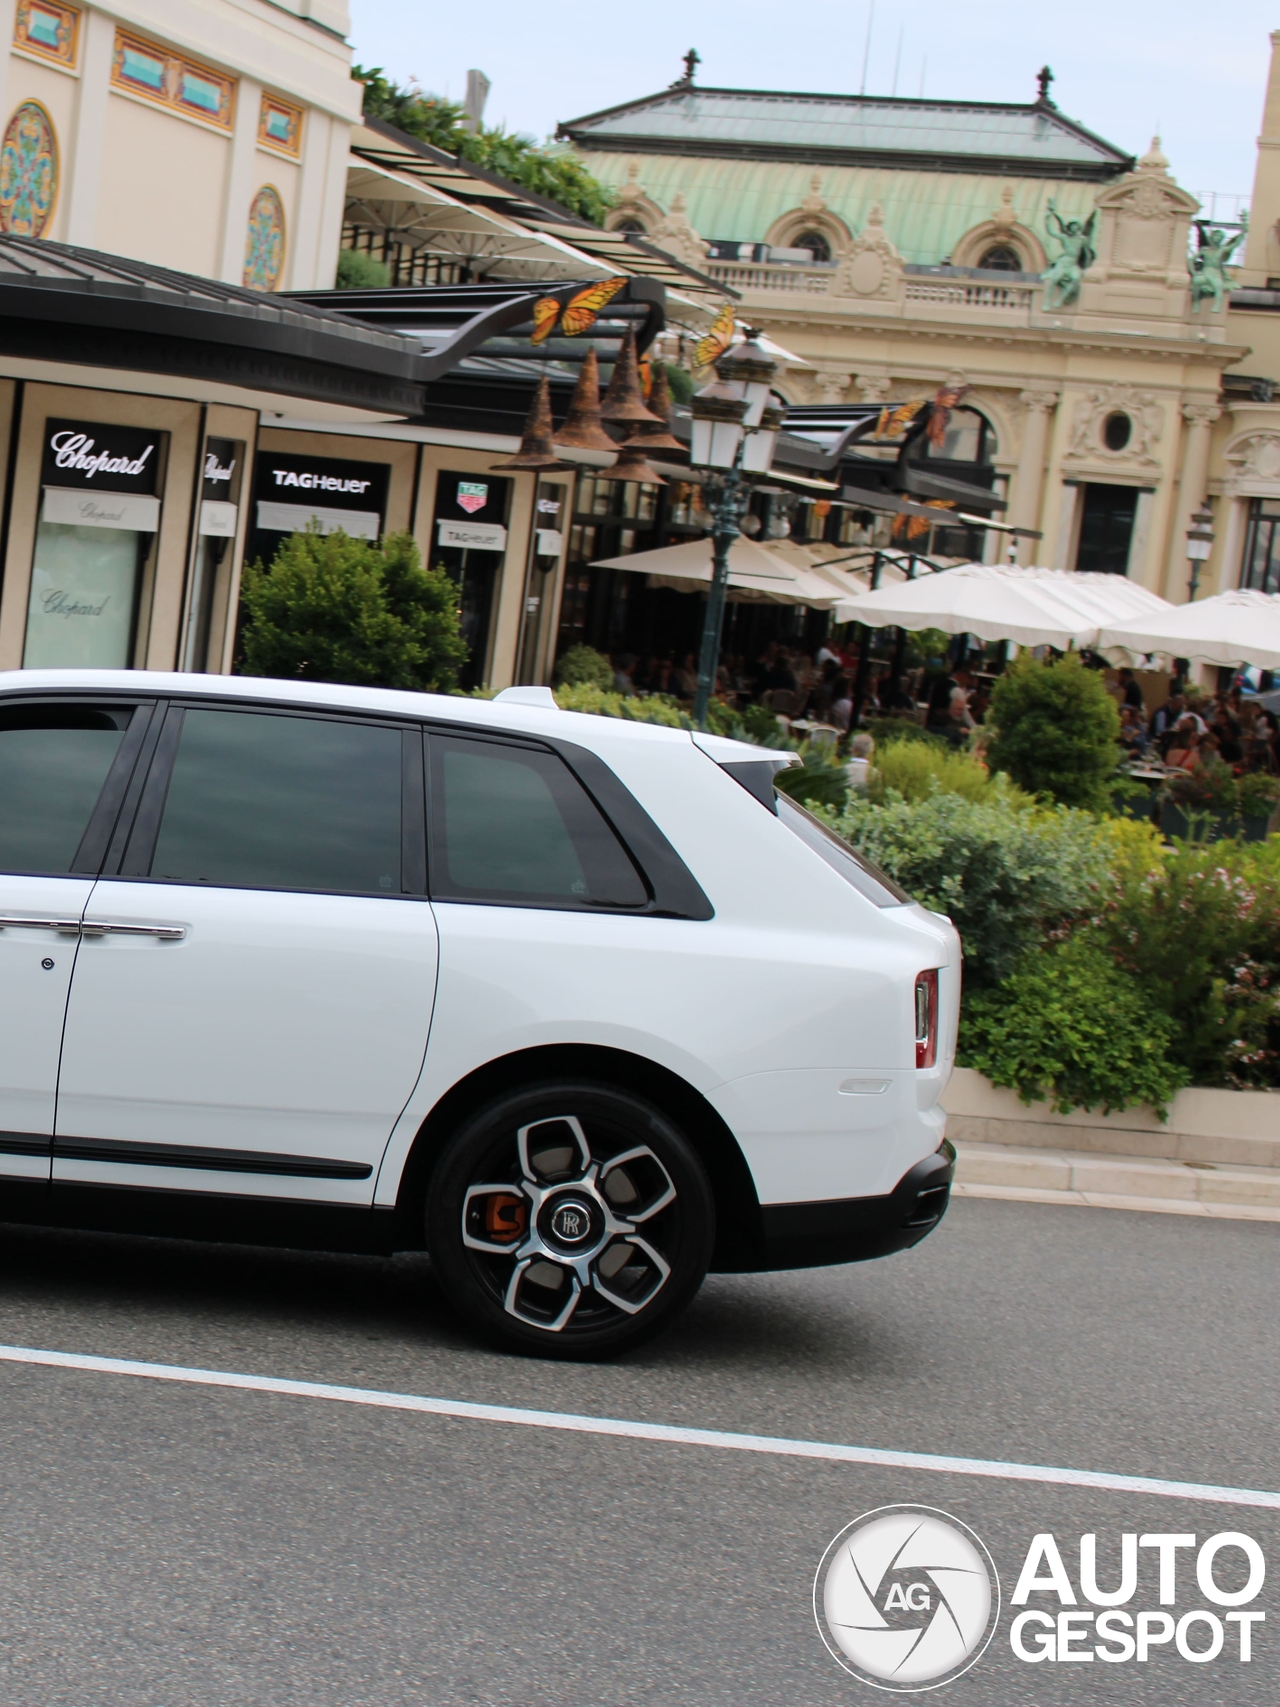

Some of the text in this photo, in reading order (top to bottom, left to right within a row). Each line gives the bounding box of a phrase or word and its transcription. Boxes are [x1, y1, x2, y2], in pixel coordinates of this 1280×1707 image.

[51, 431, 155, 478] Chopard
[461, 485, 485, 497] TAG
[78, 502, 128, 523] Chopard
[40, 588, 111, 620] Chopard
